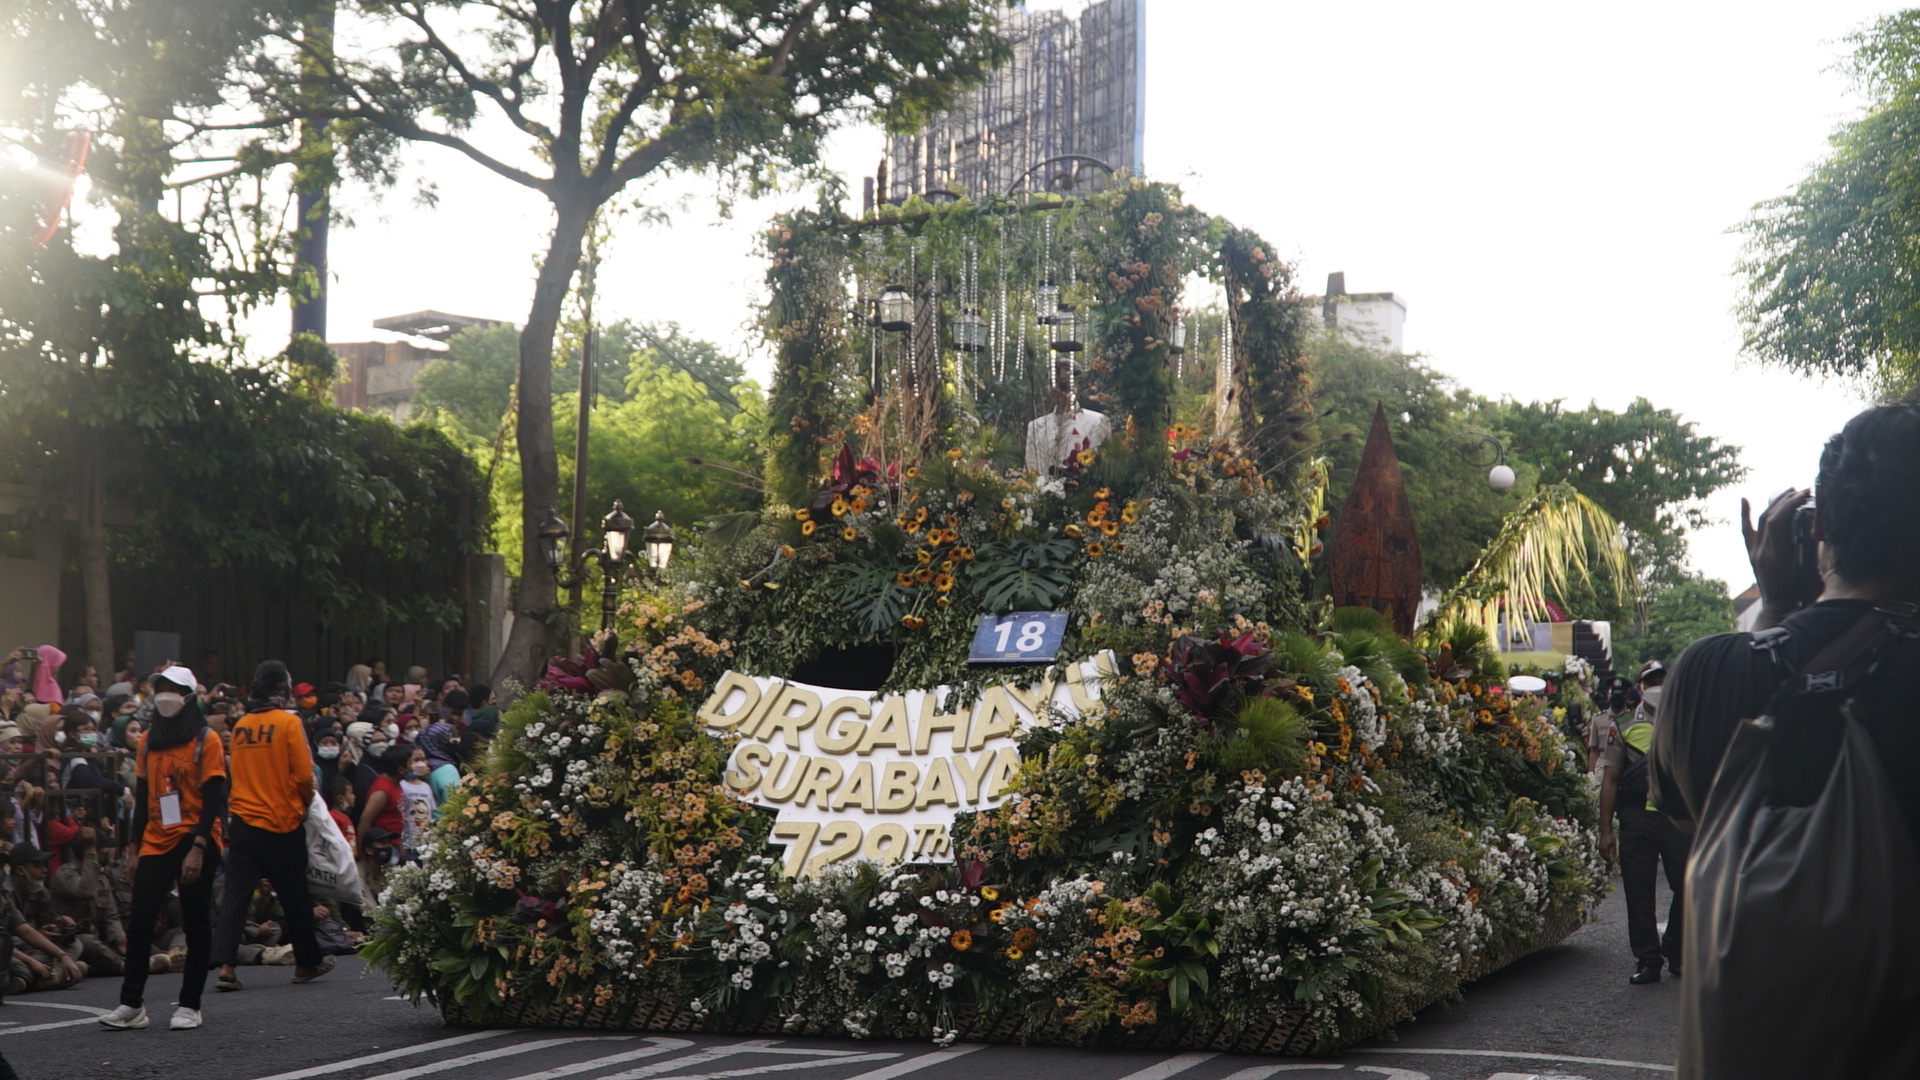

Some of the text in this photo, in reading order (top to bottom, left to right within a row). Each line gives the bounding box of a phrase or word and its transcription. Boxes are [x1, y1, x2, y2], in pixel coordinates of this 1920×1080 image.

[994, 620, 1046, 652] 18
[698, 650, 1118, 755] DIRGAHAYU
[726, 744, 1021, 812] SURABAYA
